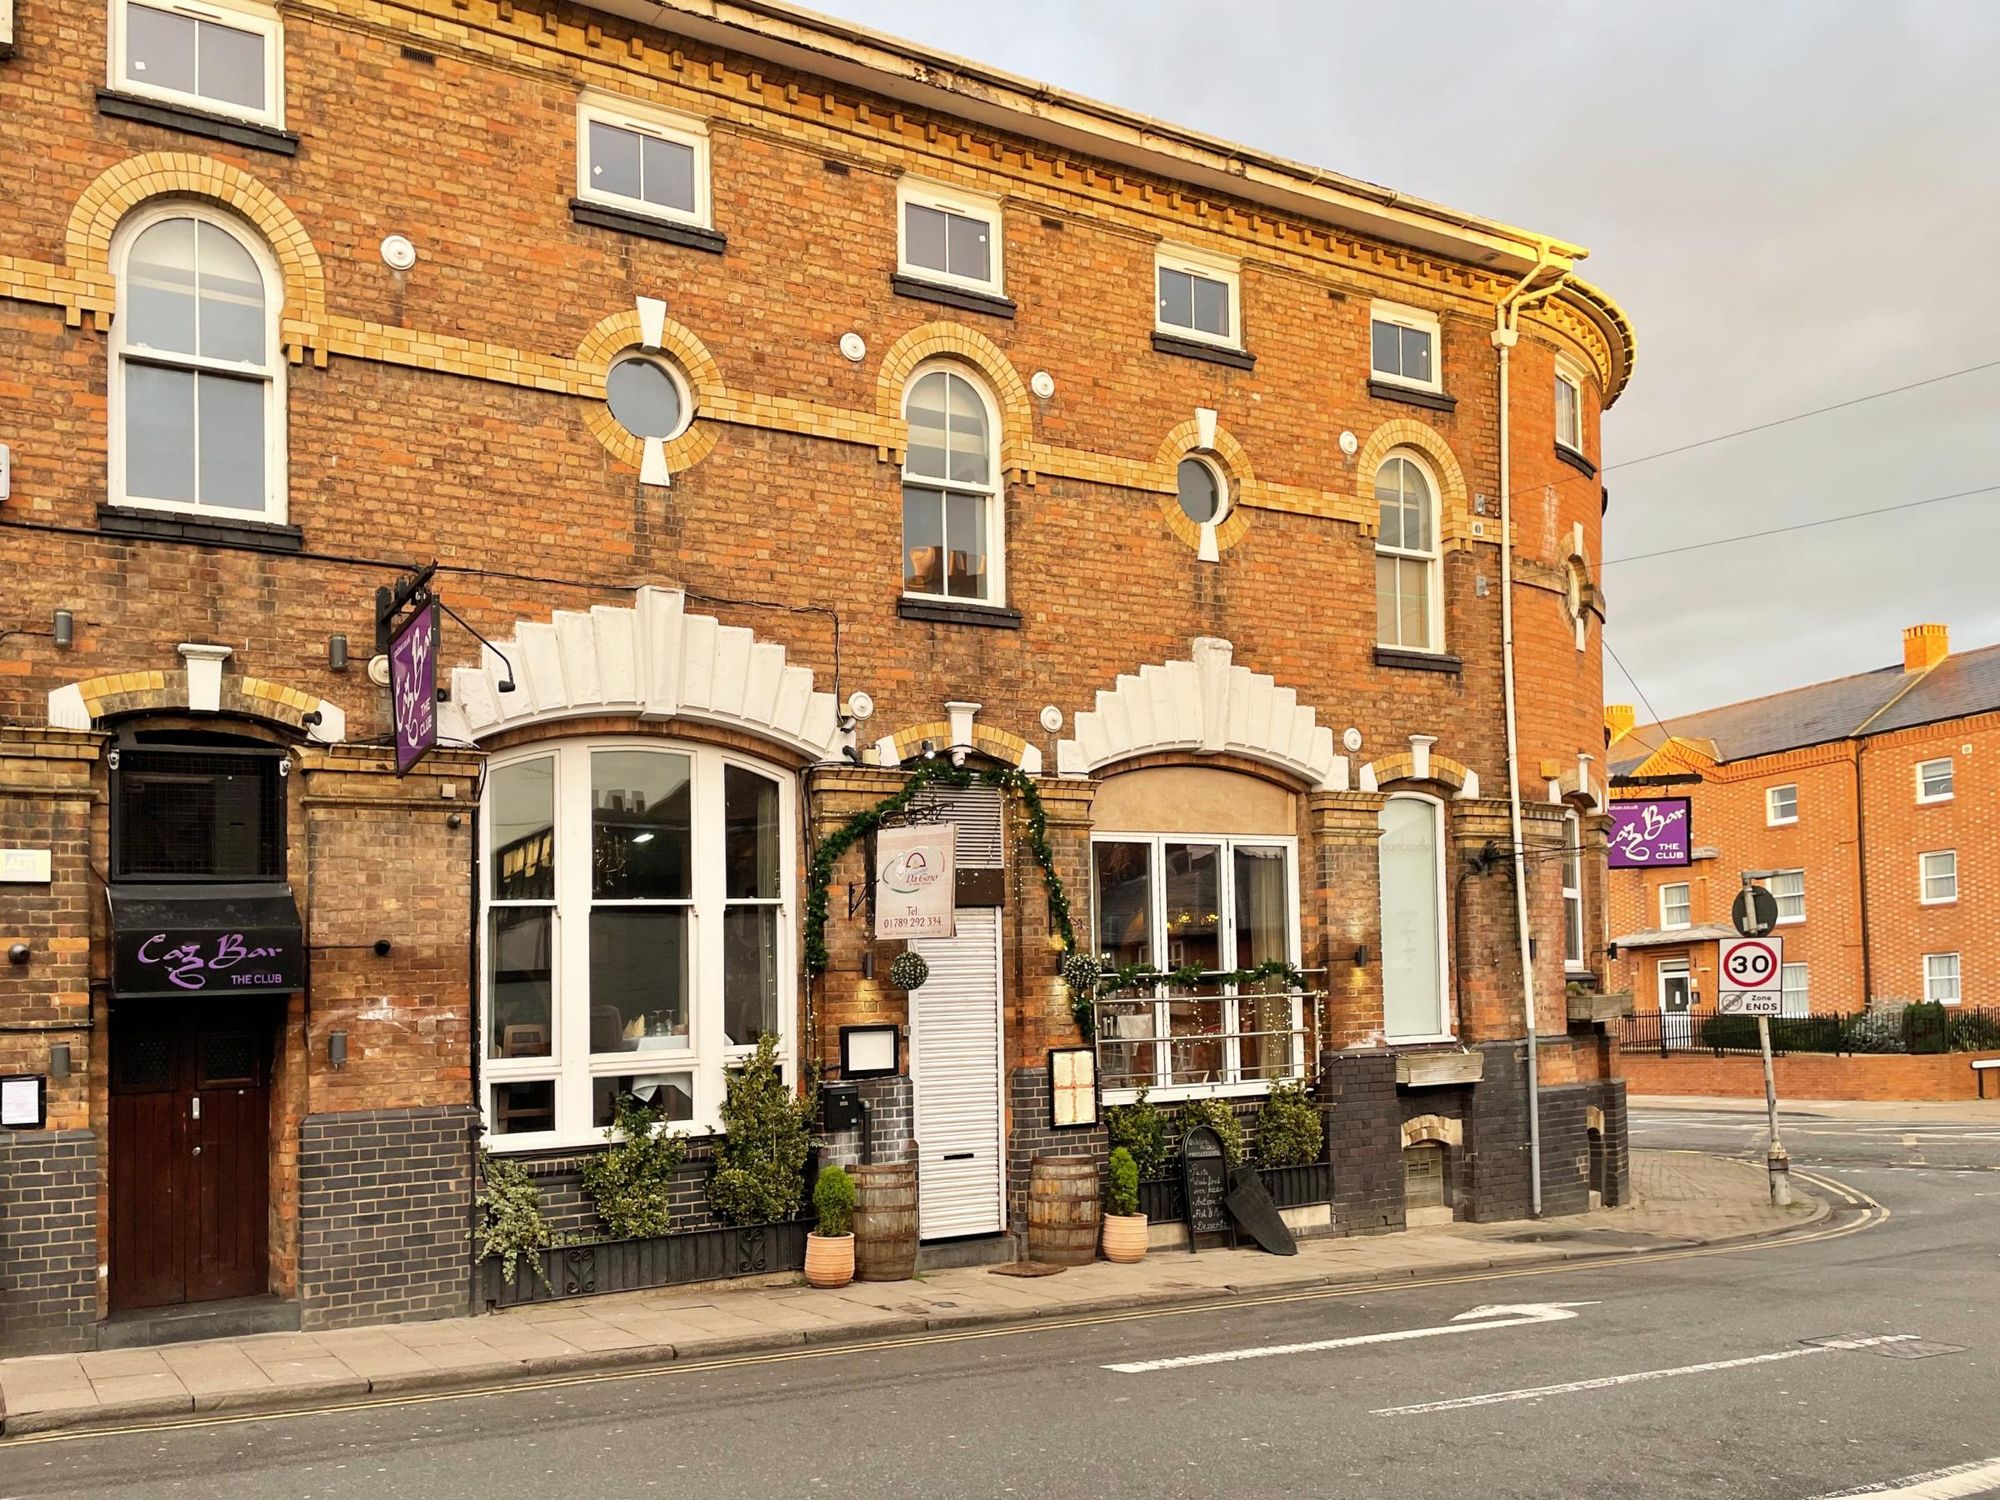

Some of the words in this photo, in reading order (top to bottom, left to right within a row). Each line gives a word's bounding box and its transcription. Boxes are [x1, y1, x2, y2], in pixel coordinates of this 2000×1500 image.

[420, 698, 431, 716] THE
[420, 715, 431, 736] CLUB
[1607, 822, 1650, 861] az
[1641, 805, 1685, 840] Bar
[883, 918, 908, 929] 01789
[910, 917, 925, 927] 292
[138, 933, 206, 989] Caz
[208, 933, 283, 969] Bar
[1732, 955, 1769, 973] 30
[231, 974, 252, 985] THE
[254, 973, 282, 984] CLUB
[1746, 1003, 1778, 1011] ENDS
